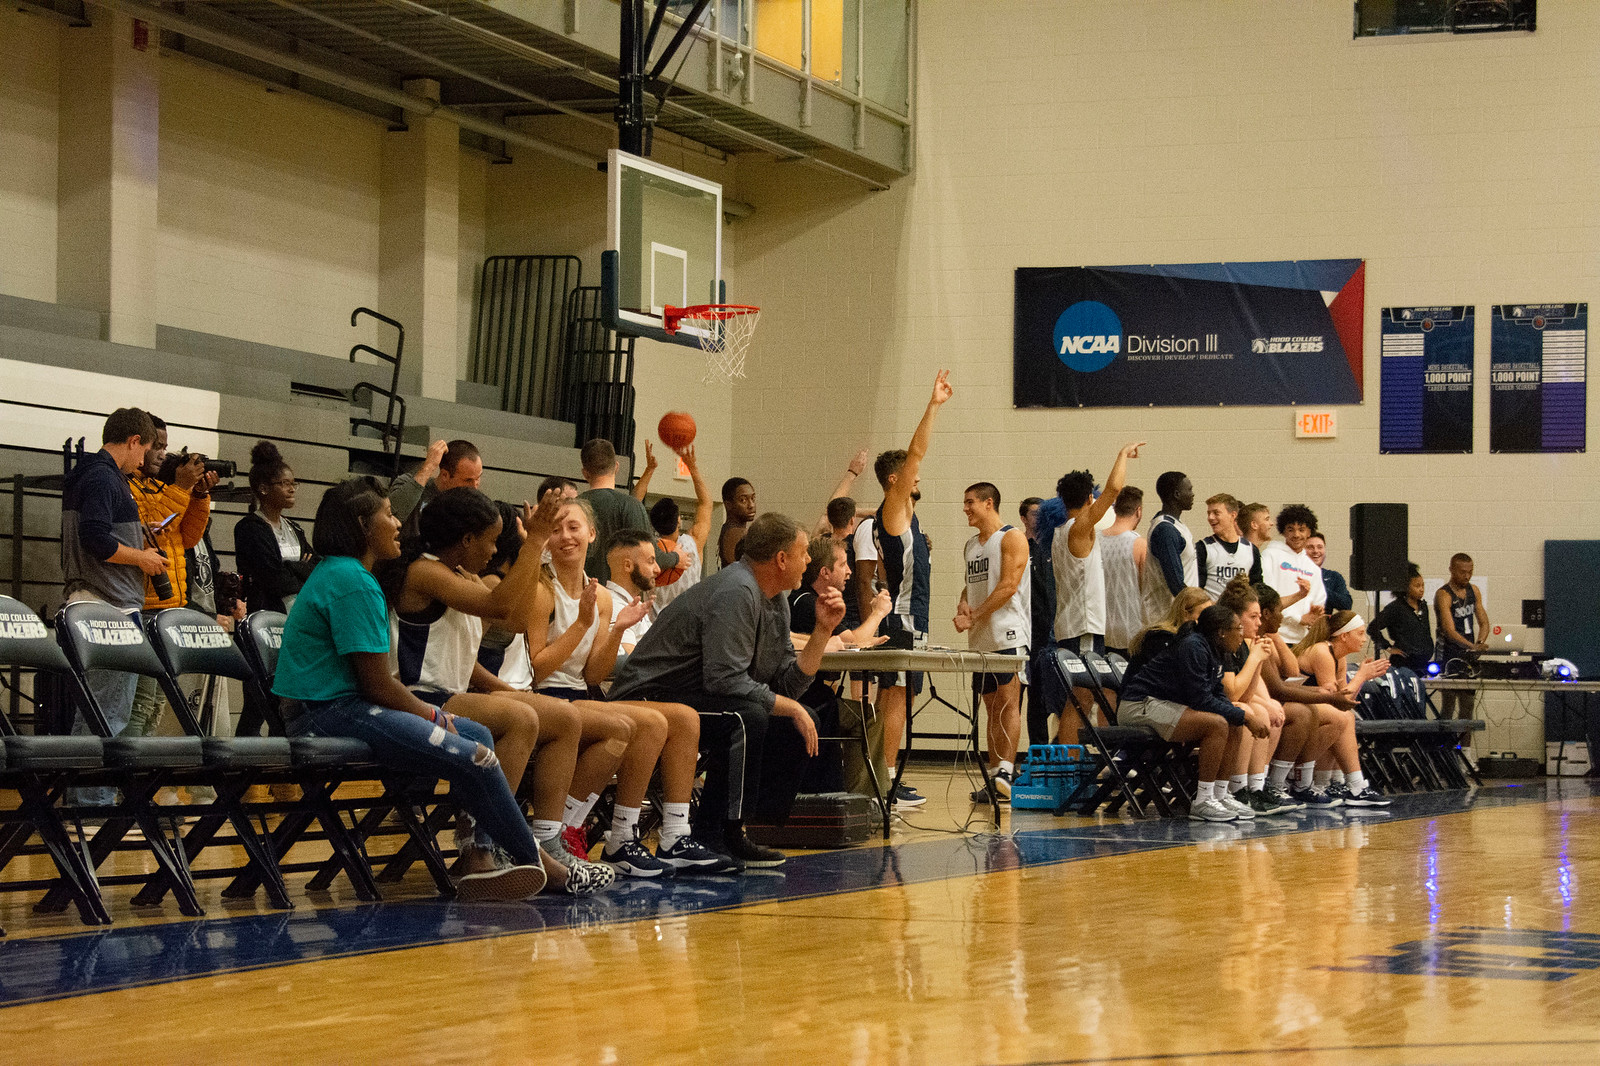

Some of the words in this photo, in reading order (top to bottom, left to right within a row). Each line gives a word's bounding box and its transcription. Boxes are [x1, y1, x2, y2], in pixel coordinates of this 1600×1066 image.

[1060, 335, 1120, 354] NCAA
[1127, 334, 1199, 353] Division
[1268, 341, 1324, 354] BLAZERS
[1447, 372, 1472, 383] POINT
[1515, 371, 1540, 382] POINT
[1303, 413, 1330, 433] EXIT
[967, 557, 989, 575] HOOD
[0, 621, 48, 639] LAZERS
[90, 619, 108, 628] HOOD
[180, 625, 198, 633] HOOD
[92, 628, 144, 646] BLAZERS
[182, 633, 232, 649] BLAZERS
